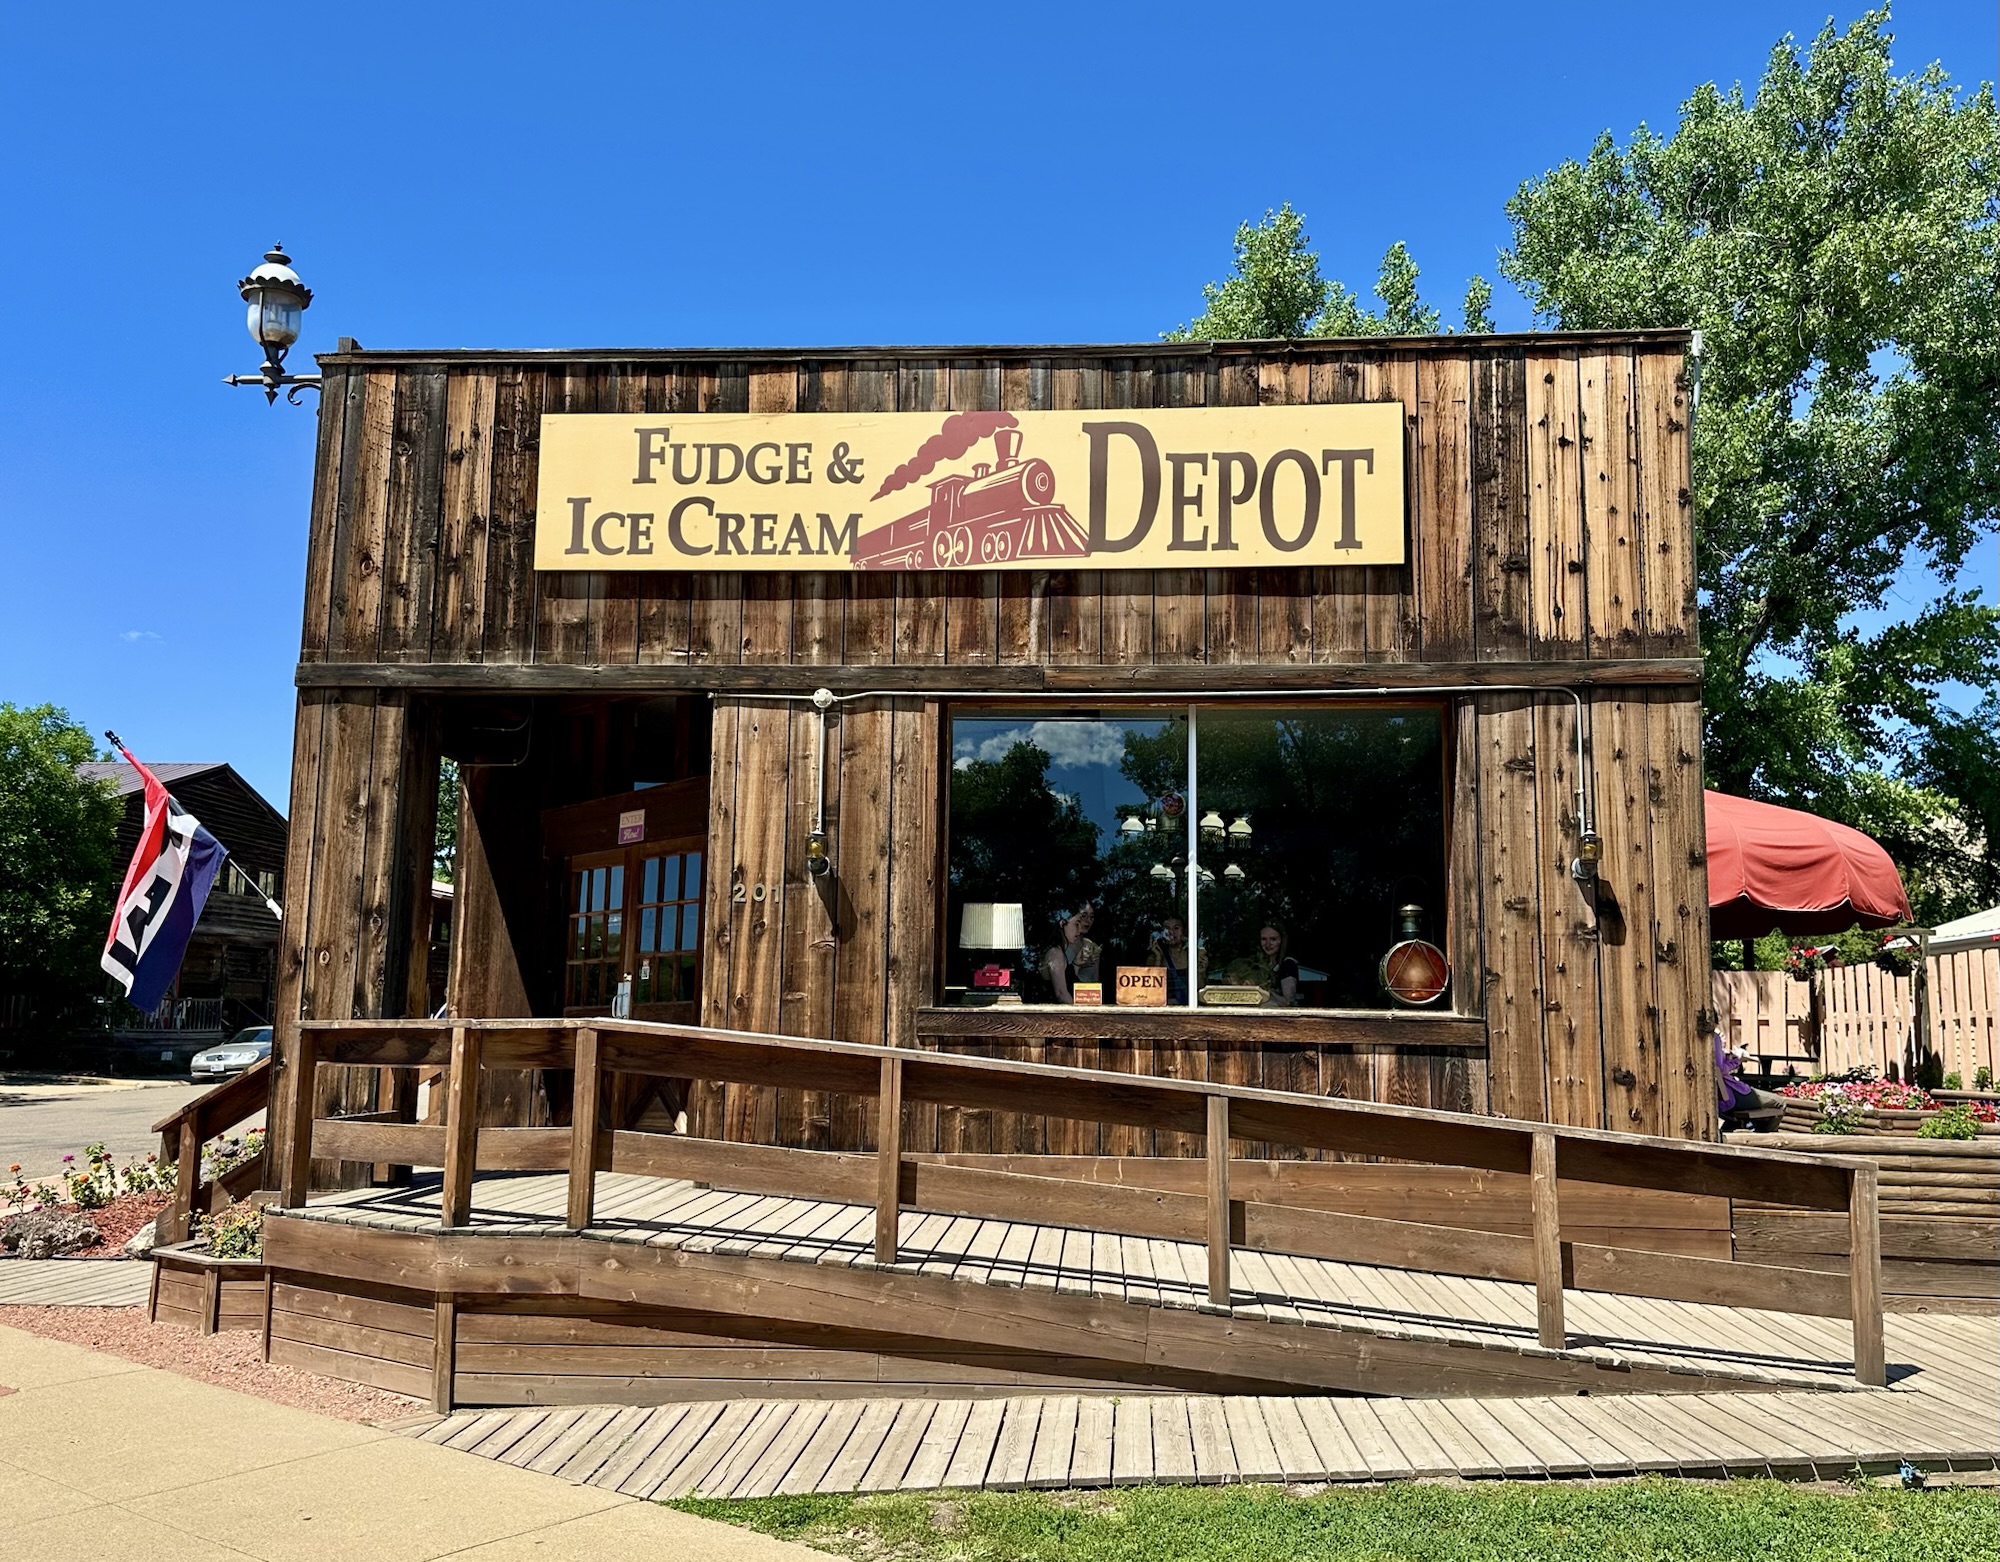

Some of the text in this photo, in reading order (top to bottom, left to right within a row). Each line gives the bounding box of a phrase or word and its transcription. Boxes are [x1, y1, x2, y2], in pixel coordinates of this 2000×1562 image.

[633, 428, 864, 485] FUDGE &
[1082, 421, 1374, 553] DEPOT
[565, 496, 863, 555] ICE CREAM
[621, 813, 643, 826] ENTER
[733, 883, 779, 902] 201
[1119, 974, 1164, 988] OPEN
